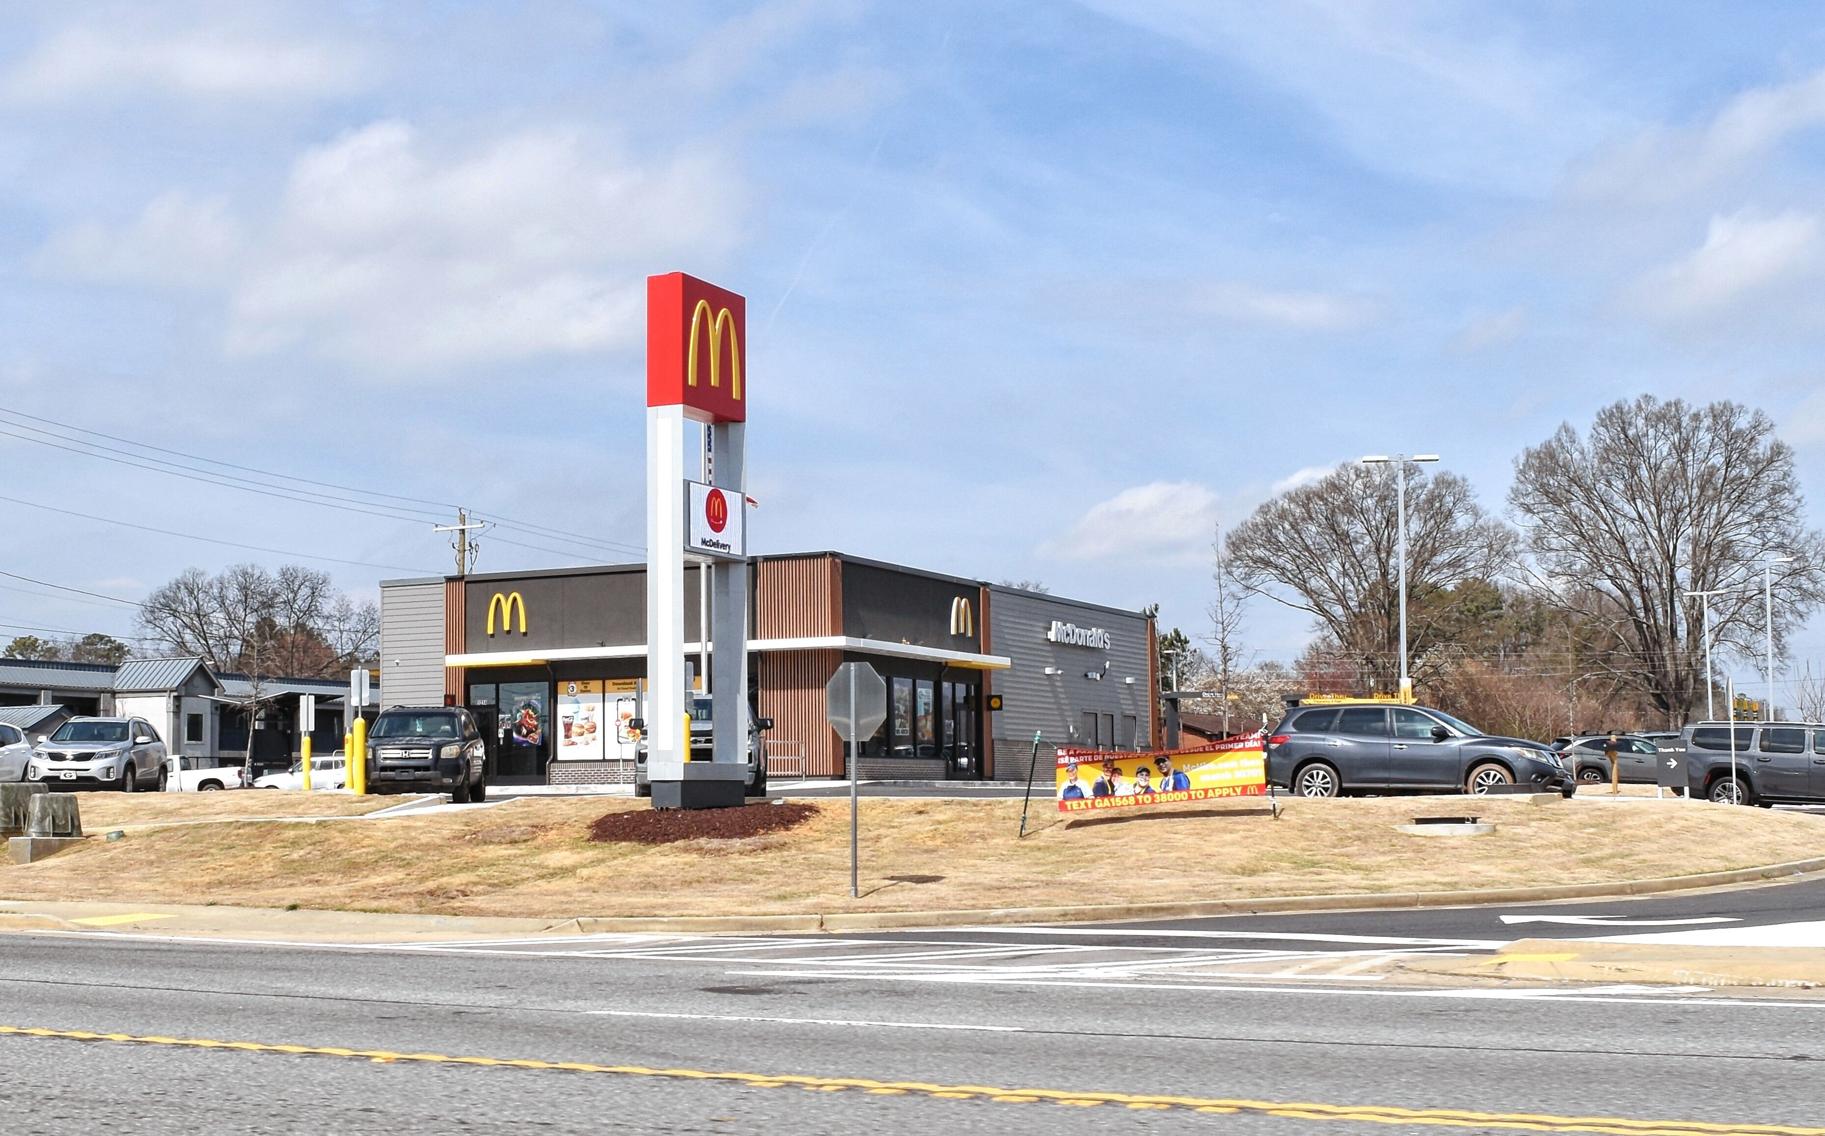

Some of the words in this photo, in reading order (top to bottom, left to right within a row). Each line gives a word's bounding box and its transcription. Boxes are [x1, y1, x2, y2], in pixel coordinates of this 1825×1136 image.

[701, 537, 731, 553] McDelivery
[1048, 620, 1111, 650] McDonald's
[1065, 799, 1093, 811] TEXT
[1095, 796, 1136, 808] GA1568
[1136, 794, 1152, 804] TO
[1154, 791, 1189, 803] 38000
[1190, 790, 1205, 800] TO
[1207, 786, 1243, 798] APPLY
